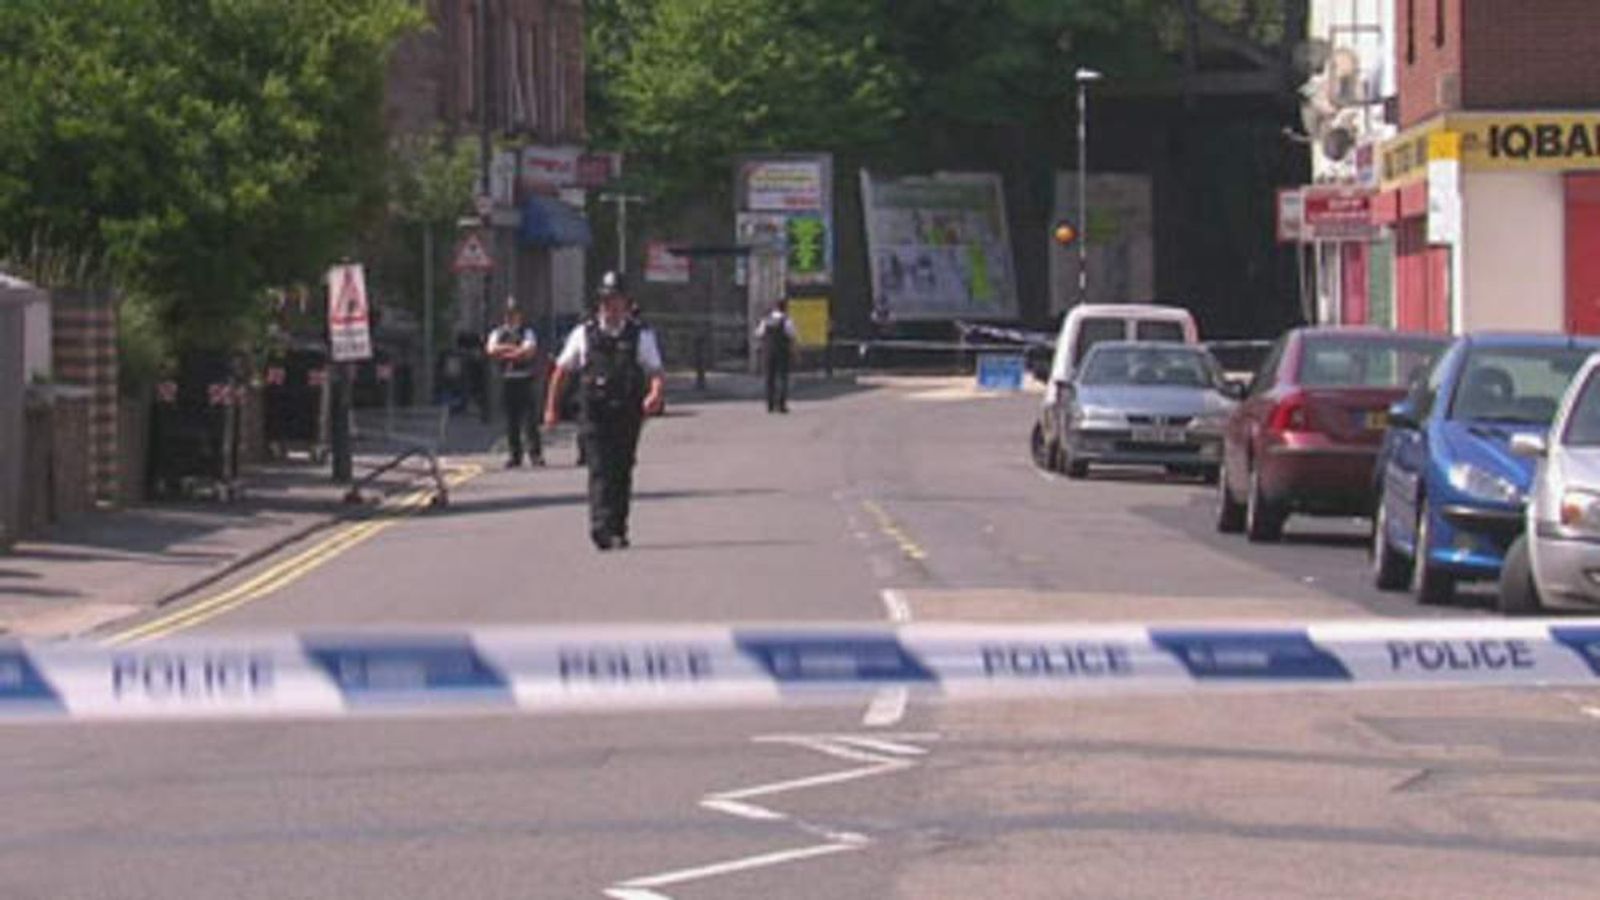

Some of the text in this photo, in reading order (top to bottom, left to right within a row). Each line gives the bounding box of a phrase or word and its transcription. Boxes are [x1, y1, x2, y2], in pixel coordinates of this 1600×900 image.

[1489, 122, 1600, 160] IQBA
[112, 647, 275, 697] POLICE
[557, 645, 711, 687] POLICE
[980, 642, 1132, 678] POLICE
[1387, 638, 1534, 670] POLICE
